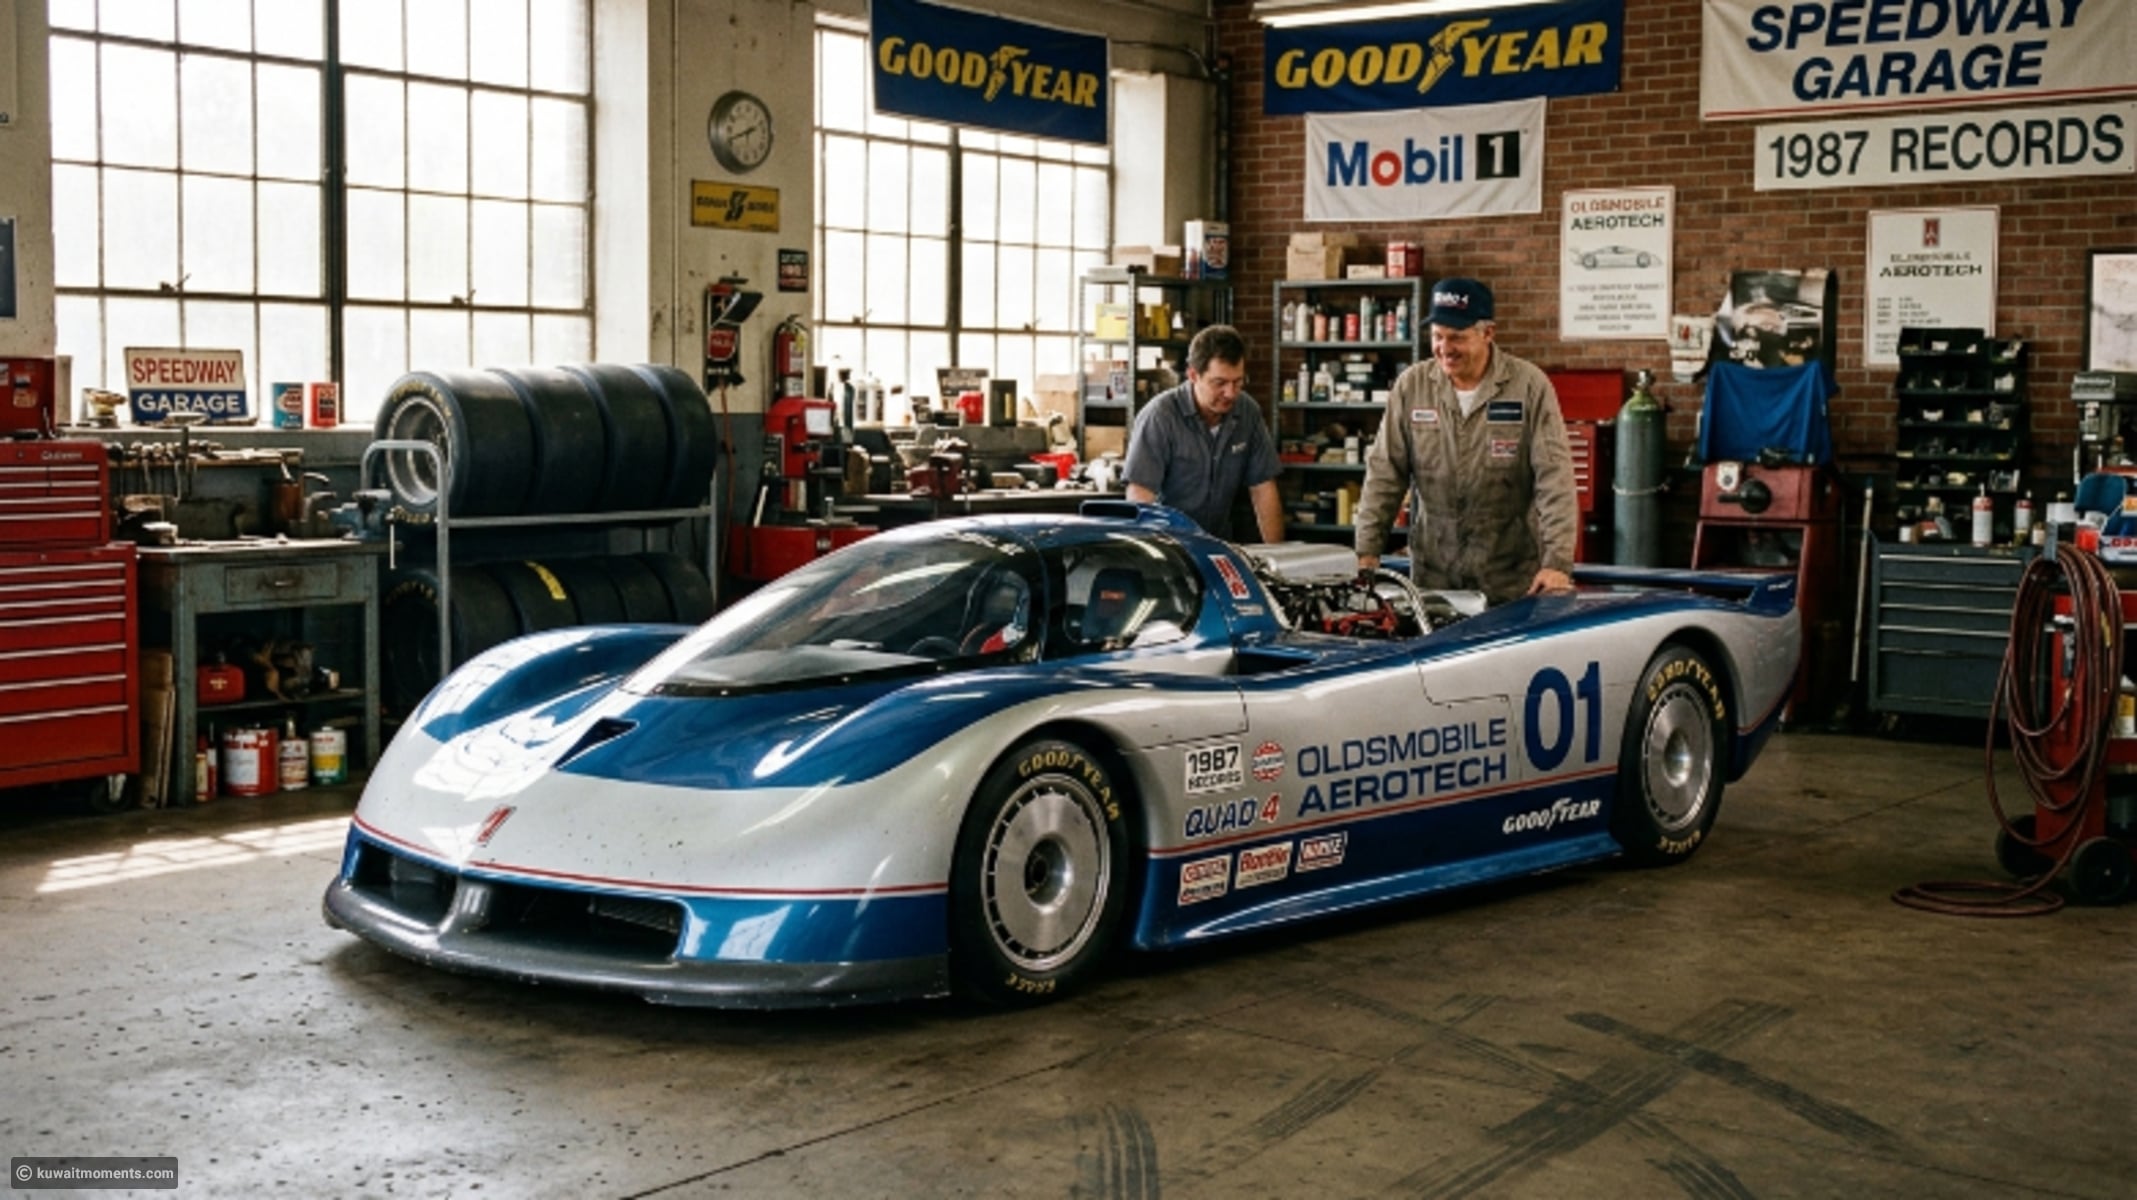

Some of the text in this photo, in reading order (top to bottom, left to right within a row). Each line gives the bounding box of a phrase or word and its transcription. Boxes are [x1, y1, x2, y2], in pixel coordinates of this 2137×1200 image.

[1746, 0, 2086, 52] SPEEDWAY
[1792, 40, 2048, 102] GARAGE
[1326, 133, 1463, 187] Mobil
[1768, 113, 2125, 179] 1987 RECORDS
[1570, 213, 1665, 231] AEROTECH
[1879, 264, 1983, 277] AEROTECH
[132, 357, 236, 383] SPEEDWAY
[138, 393, 240, 413] GARAGE
[1523, 660, 1600, 772] 01
[1188, 746, 1239, 774] 1987
[1297, 718, 1506, 778] OLDSMOBILE
[1297, 752, 1507, 818] AEROTECH
[1184, 792, 1280, 838] QUAD 4
